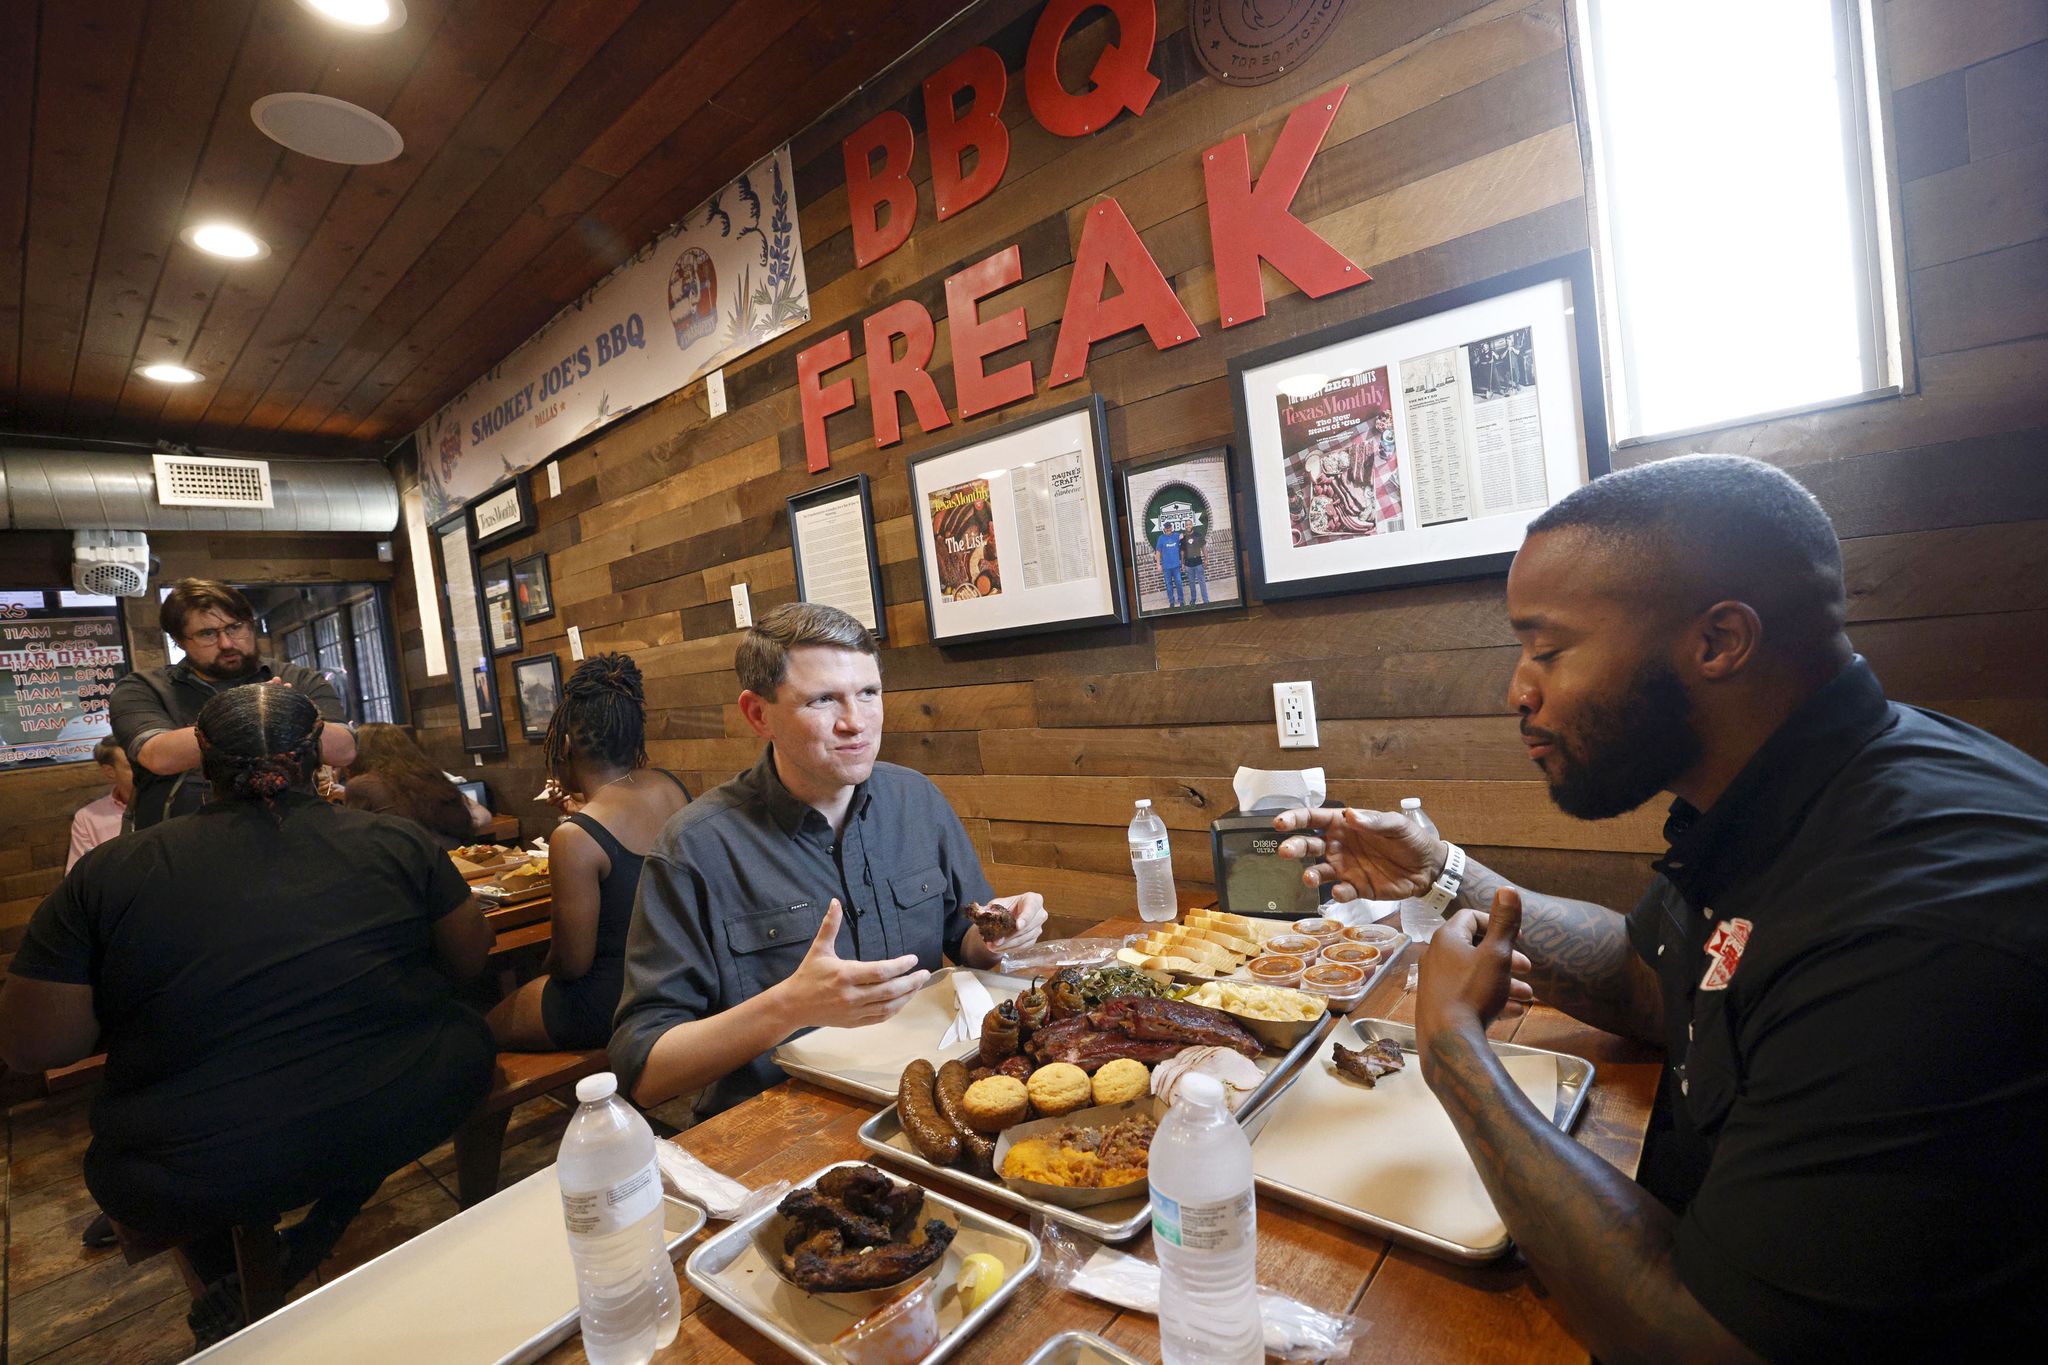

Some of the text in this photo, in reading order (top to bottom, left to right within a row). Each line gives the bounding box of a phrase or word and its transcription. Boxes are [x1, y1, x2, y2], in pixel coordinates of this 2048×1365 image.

[1231, 54, 1257, 69] TOP
[1262, 50, 1281, 66] 50
[844, 0, 1161, 270] BBQ
[797, 84, 1373, 474] FREAK
[472, 382, 535, 446] SMOKEY
[538, 345, 592, 402] JOE'S
[595, 313, 647, 367] BBQ
[1324, 378, 1351, 393] BBQ
[1351, 370, 1377, 388] JOINTS
[534, 402, 558, 428] DALLAS
[1315, 413, 1351, 427] The New
[1308, 424, 1331, 436] Stars
[1331, 421, 1341, 431] of
[1076, 455, 1080, 463] 7
[945, 536, 965, 554] The
[4, 626, 51, 640] 11AM
[73, 623, 113, 637] 5PM
[25, 639, 98, 653] CLOSED
[10, 659, 55, 672] 11AM
[13, 671, 60, 686] 11AM
[75, 667, 114, 682] 8PM
[15, 687, 62, 702] 11AM
[78, 683, 116, 698] 8PM
[18, 703, 63, 717] 11AM
[21, 717, 66, 732] 11AM
